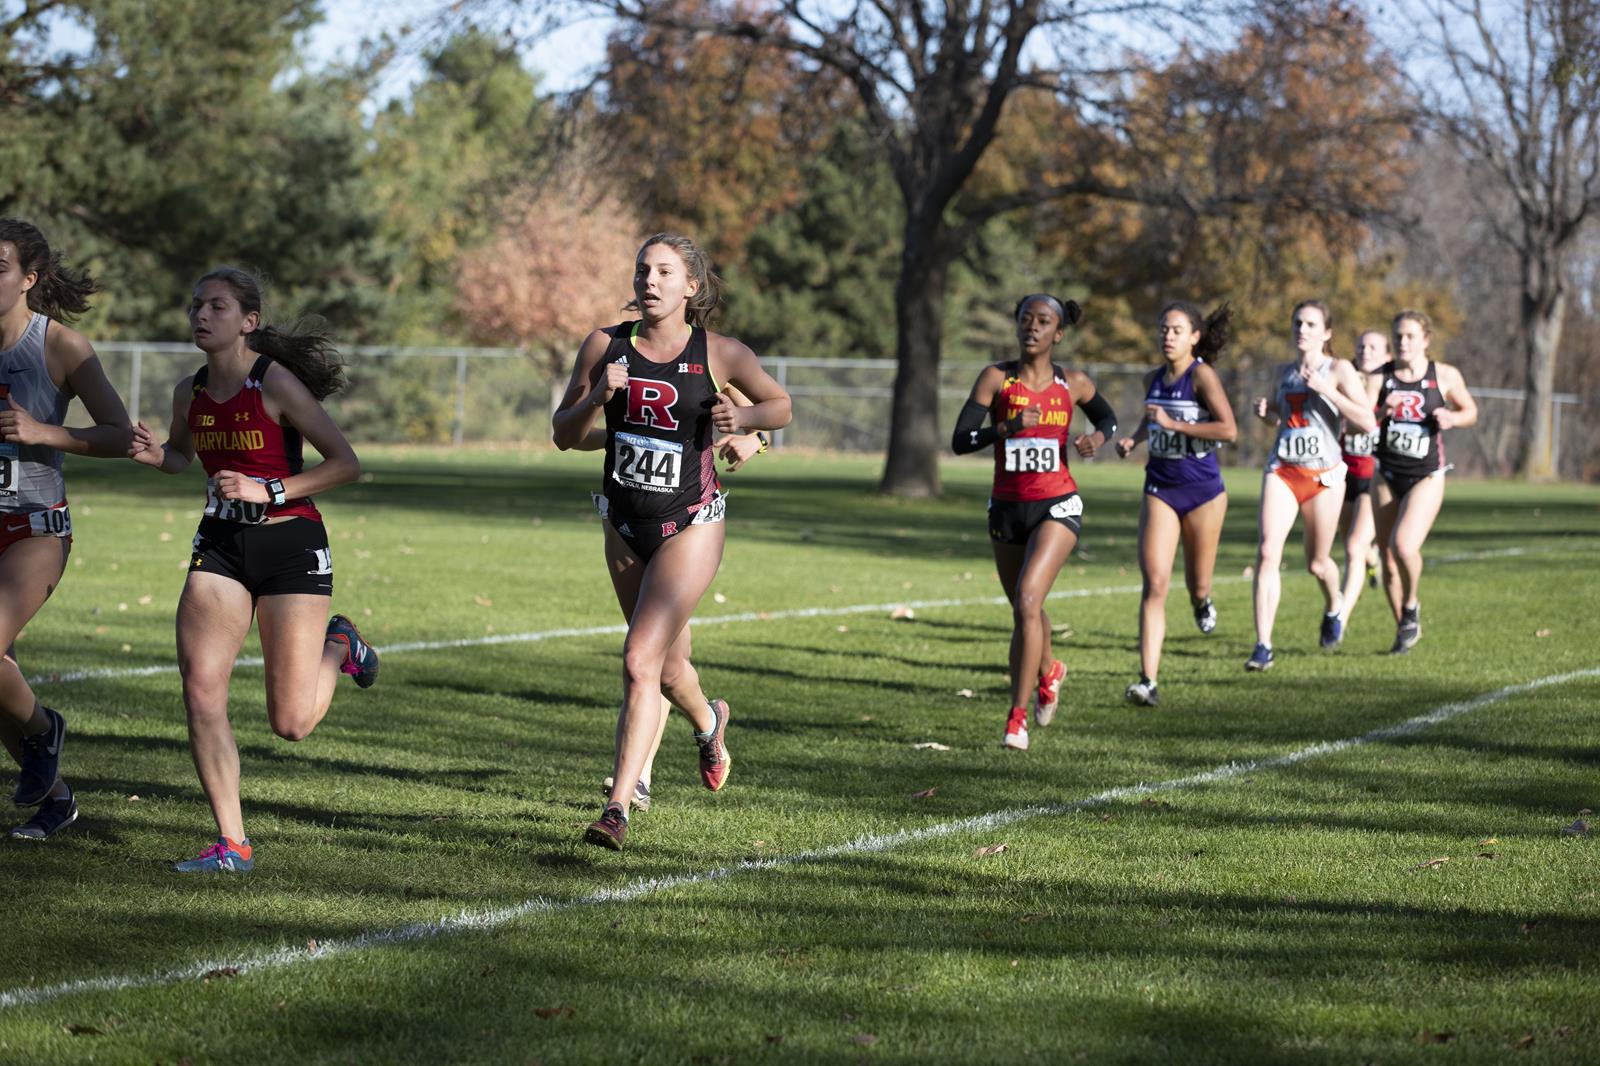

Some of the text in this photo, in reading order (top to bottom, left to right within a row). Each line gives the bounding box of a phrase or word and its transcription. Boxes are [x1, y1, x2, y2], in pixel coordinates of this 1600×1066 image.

[624, 376, 680, 431] R
[1011, 447, 1055, 472] 139
[1285, 436, 1319, 457] 108
[618, 444, 676, 486] 244
[41, 507, 71, 534] 109
